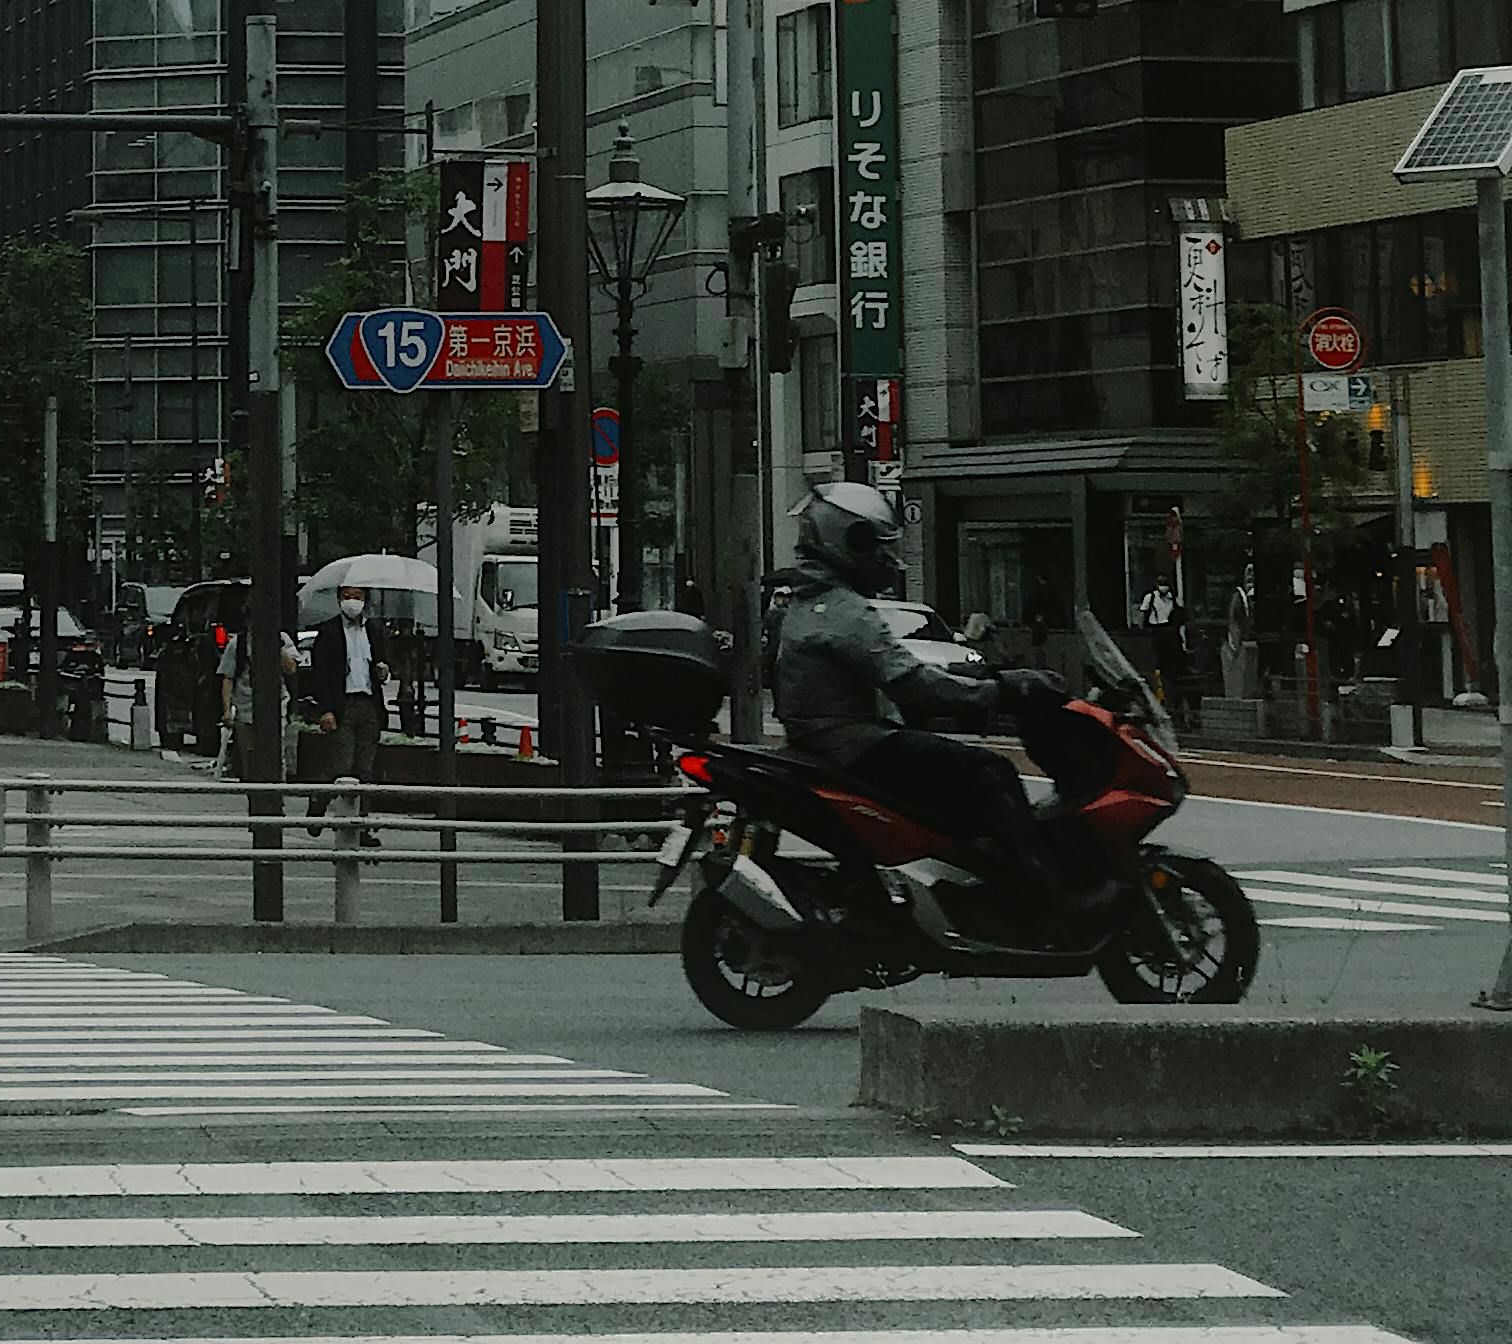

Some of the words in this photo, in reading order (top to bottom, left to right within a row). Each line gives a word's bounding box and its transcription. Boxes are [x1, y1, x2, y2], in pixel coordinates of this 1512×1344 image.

[847, 89, 889, 329] りそな銀行
[440, 190, 482, 293] 大門
[377, 320, 429, 369] 15
[448, 324, 537, 358] 第一京浜
[1314, 332, 1356, 353] 消火栓
